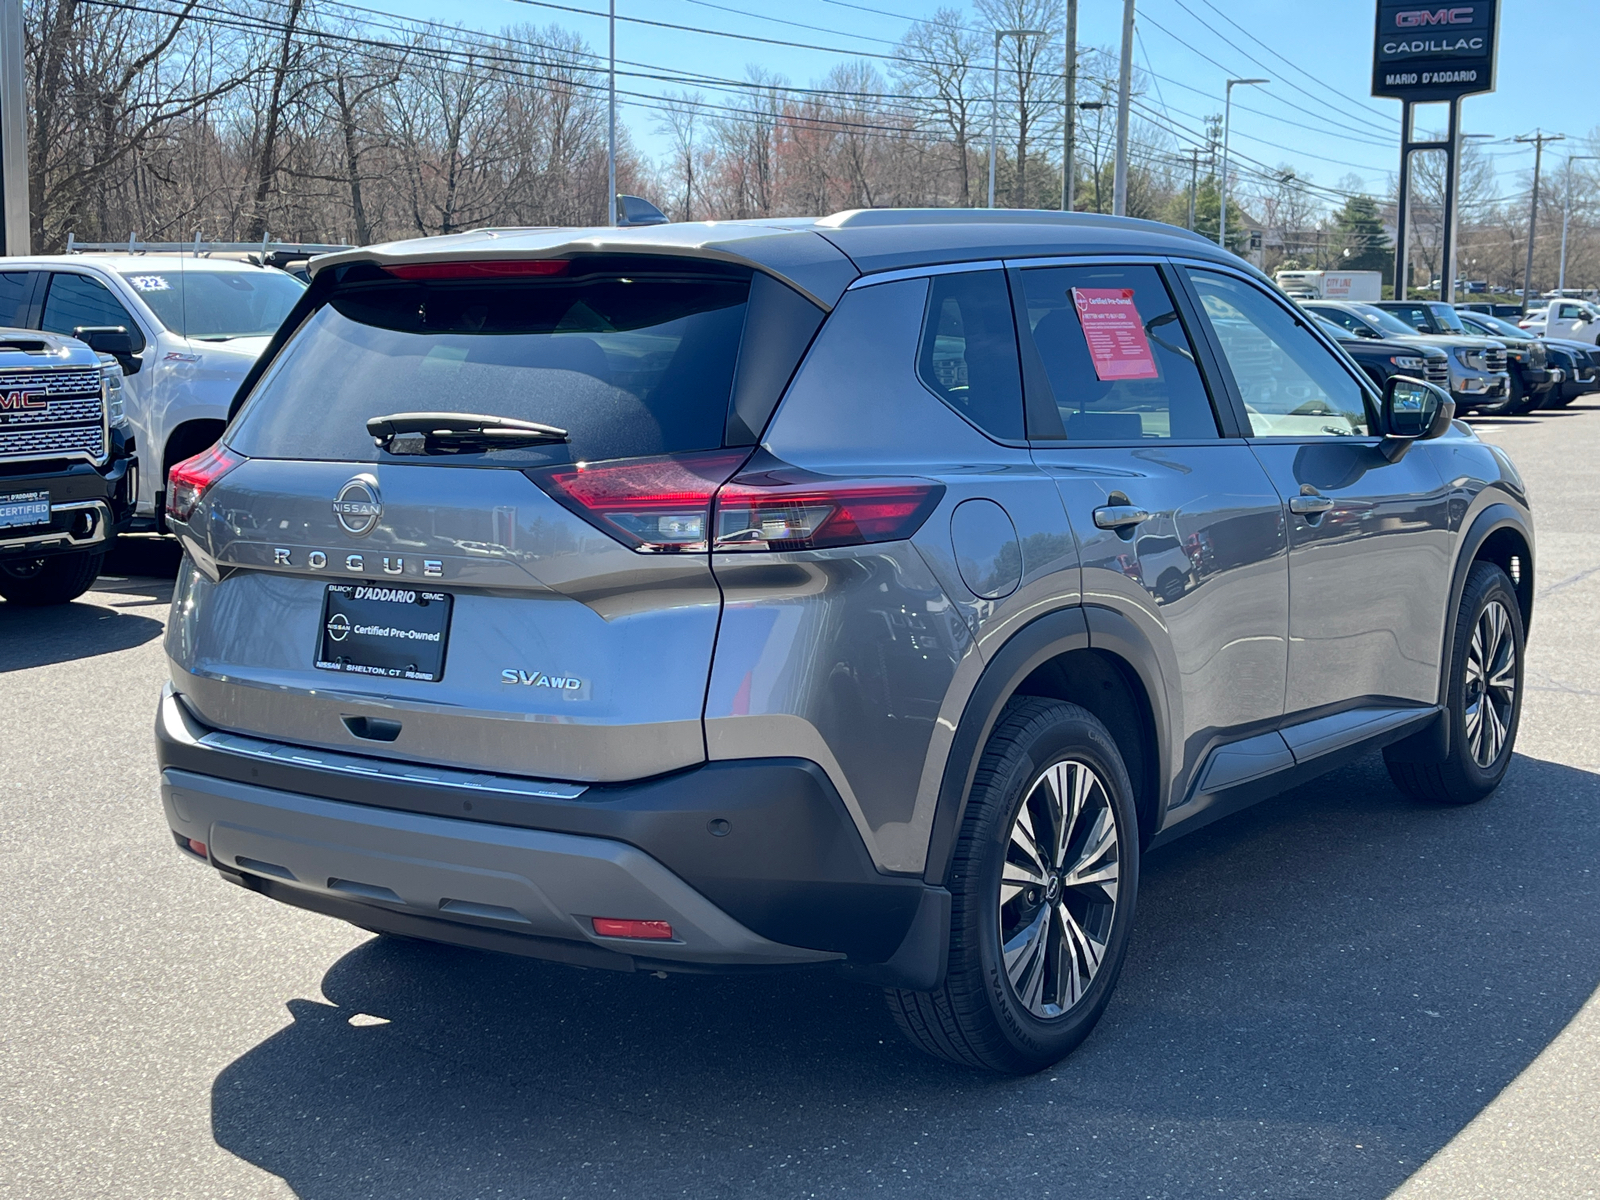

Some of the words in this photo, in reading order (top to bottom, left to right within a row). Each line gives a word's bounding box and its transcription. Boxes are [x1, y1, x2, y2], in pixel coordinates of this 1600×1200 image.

[1396, 7, 1474, 27] GMC
[1383, 38, 1483, 54] CADILLAC
[1386, 73, 1418, 85] MARIO
[1422, 70, 1477, 84] D'ADDARIO
[140, 278, 162, 288] 22
[0, 390, 46, 409] MC
[0, 503, 48, 517] CERTIFIED
[332, 503, 380, 514] NISSAN
[274, 548, 443, 577] ROGUE
[328, 584, 353, 592] BUICK
[354, 586, 416, 604] D'ADDARIO
[421, 592, 444, 601] GMC
[327, 623, 351, 631] NISSAN
[354, 624, 389, 637] Certified
[390, 629, 440, 642] Pre-Owned
[316, 661, 341, 670] NISSAN
[346, 664, 387, 676] SHELTON,
[388, 669, 402, 677] CT
[501, 668, 541, 686] SV
[536, 675, 582, 690] AWD
[989, 961, 1045, 1052] ONTINENTAL
